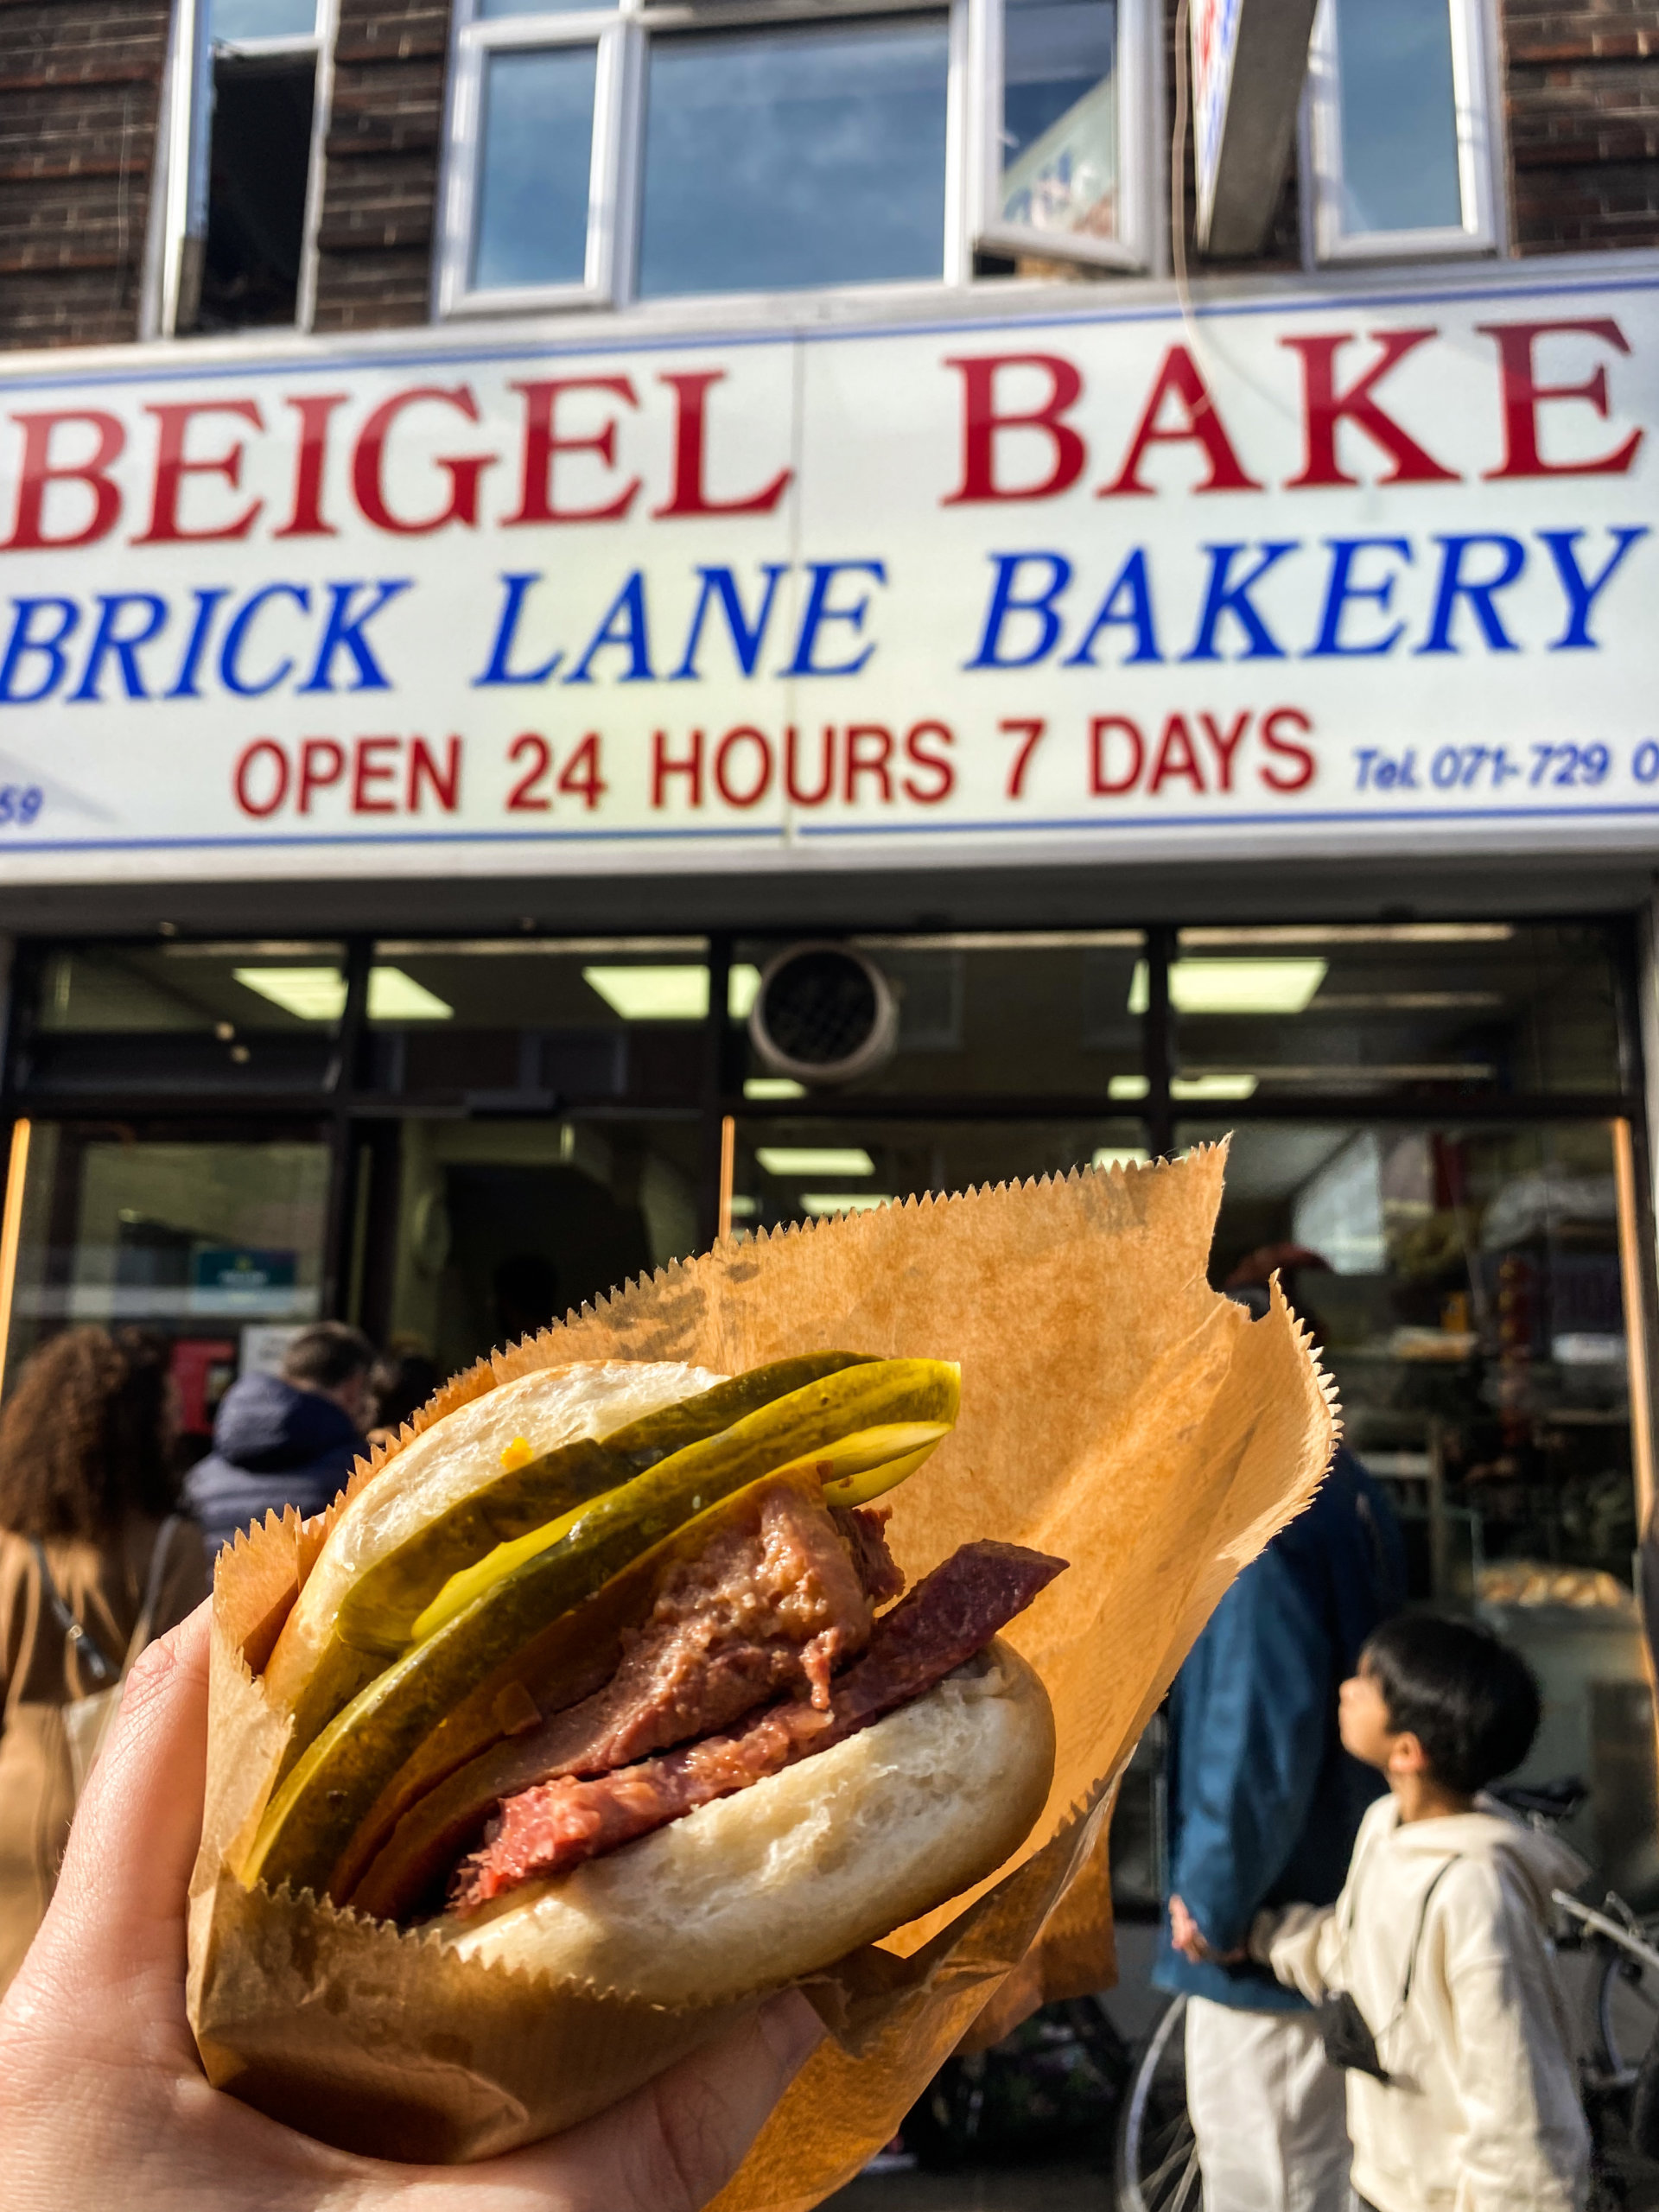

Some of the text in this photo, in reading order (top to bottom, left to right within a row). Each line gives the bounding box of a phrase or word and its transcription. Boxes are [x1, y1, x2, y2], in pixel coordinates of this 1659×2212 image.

[0, 317, 1645, 553] BEIGEL BAKE
[0, 525, 1652, 705] BRICK LANE BAKERY
[233, 707, 1317, 821] OPEN 24 HOURS 7 DAYS
[1430, 741, 1611, 790] 071-729
